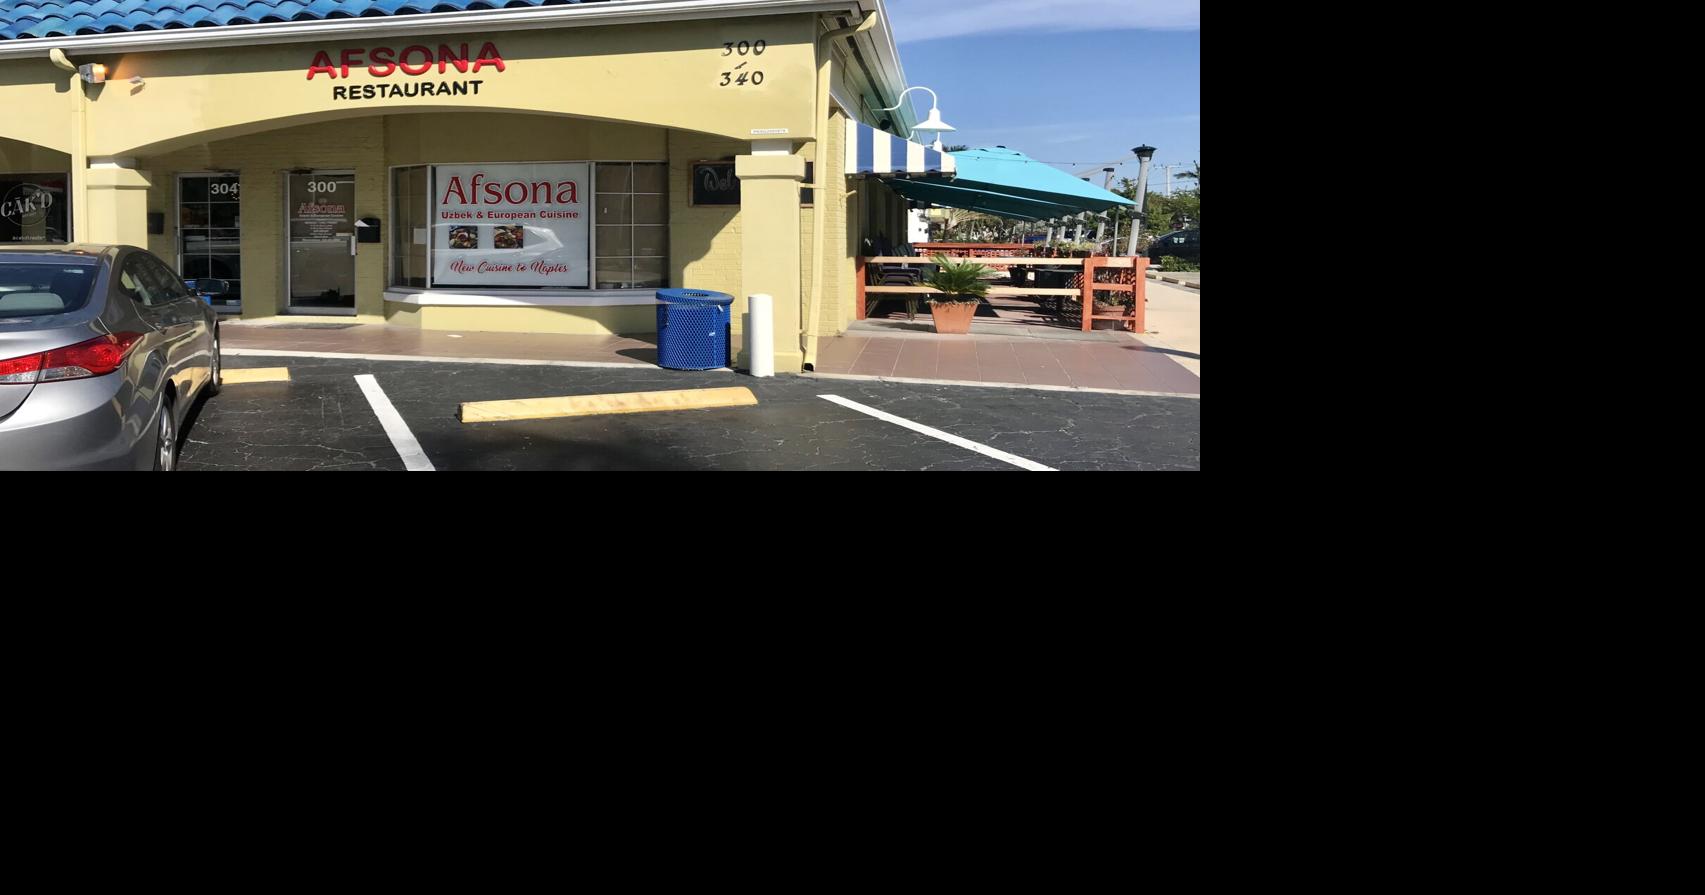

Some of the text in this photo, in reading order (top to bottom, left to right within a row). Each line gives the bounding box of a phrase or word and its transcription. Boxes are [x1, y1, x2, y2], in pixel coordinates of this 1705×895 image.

[721, 39, 766, 56] 300
[306, 41, 506, 81] AFSONA
[720, 70, 764, 87] 340
[333, 80, 483, 100] RESTAURANT
[210, 183, 238, 195] 304
[307, 181, 337, 193] 300
[442, 173, 578, 205] Afsona
[441, 210, 579, 220] Uzbek & European Cuisine
[450, 260, 569, 275] New Cuisine to Naples
